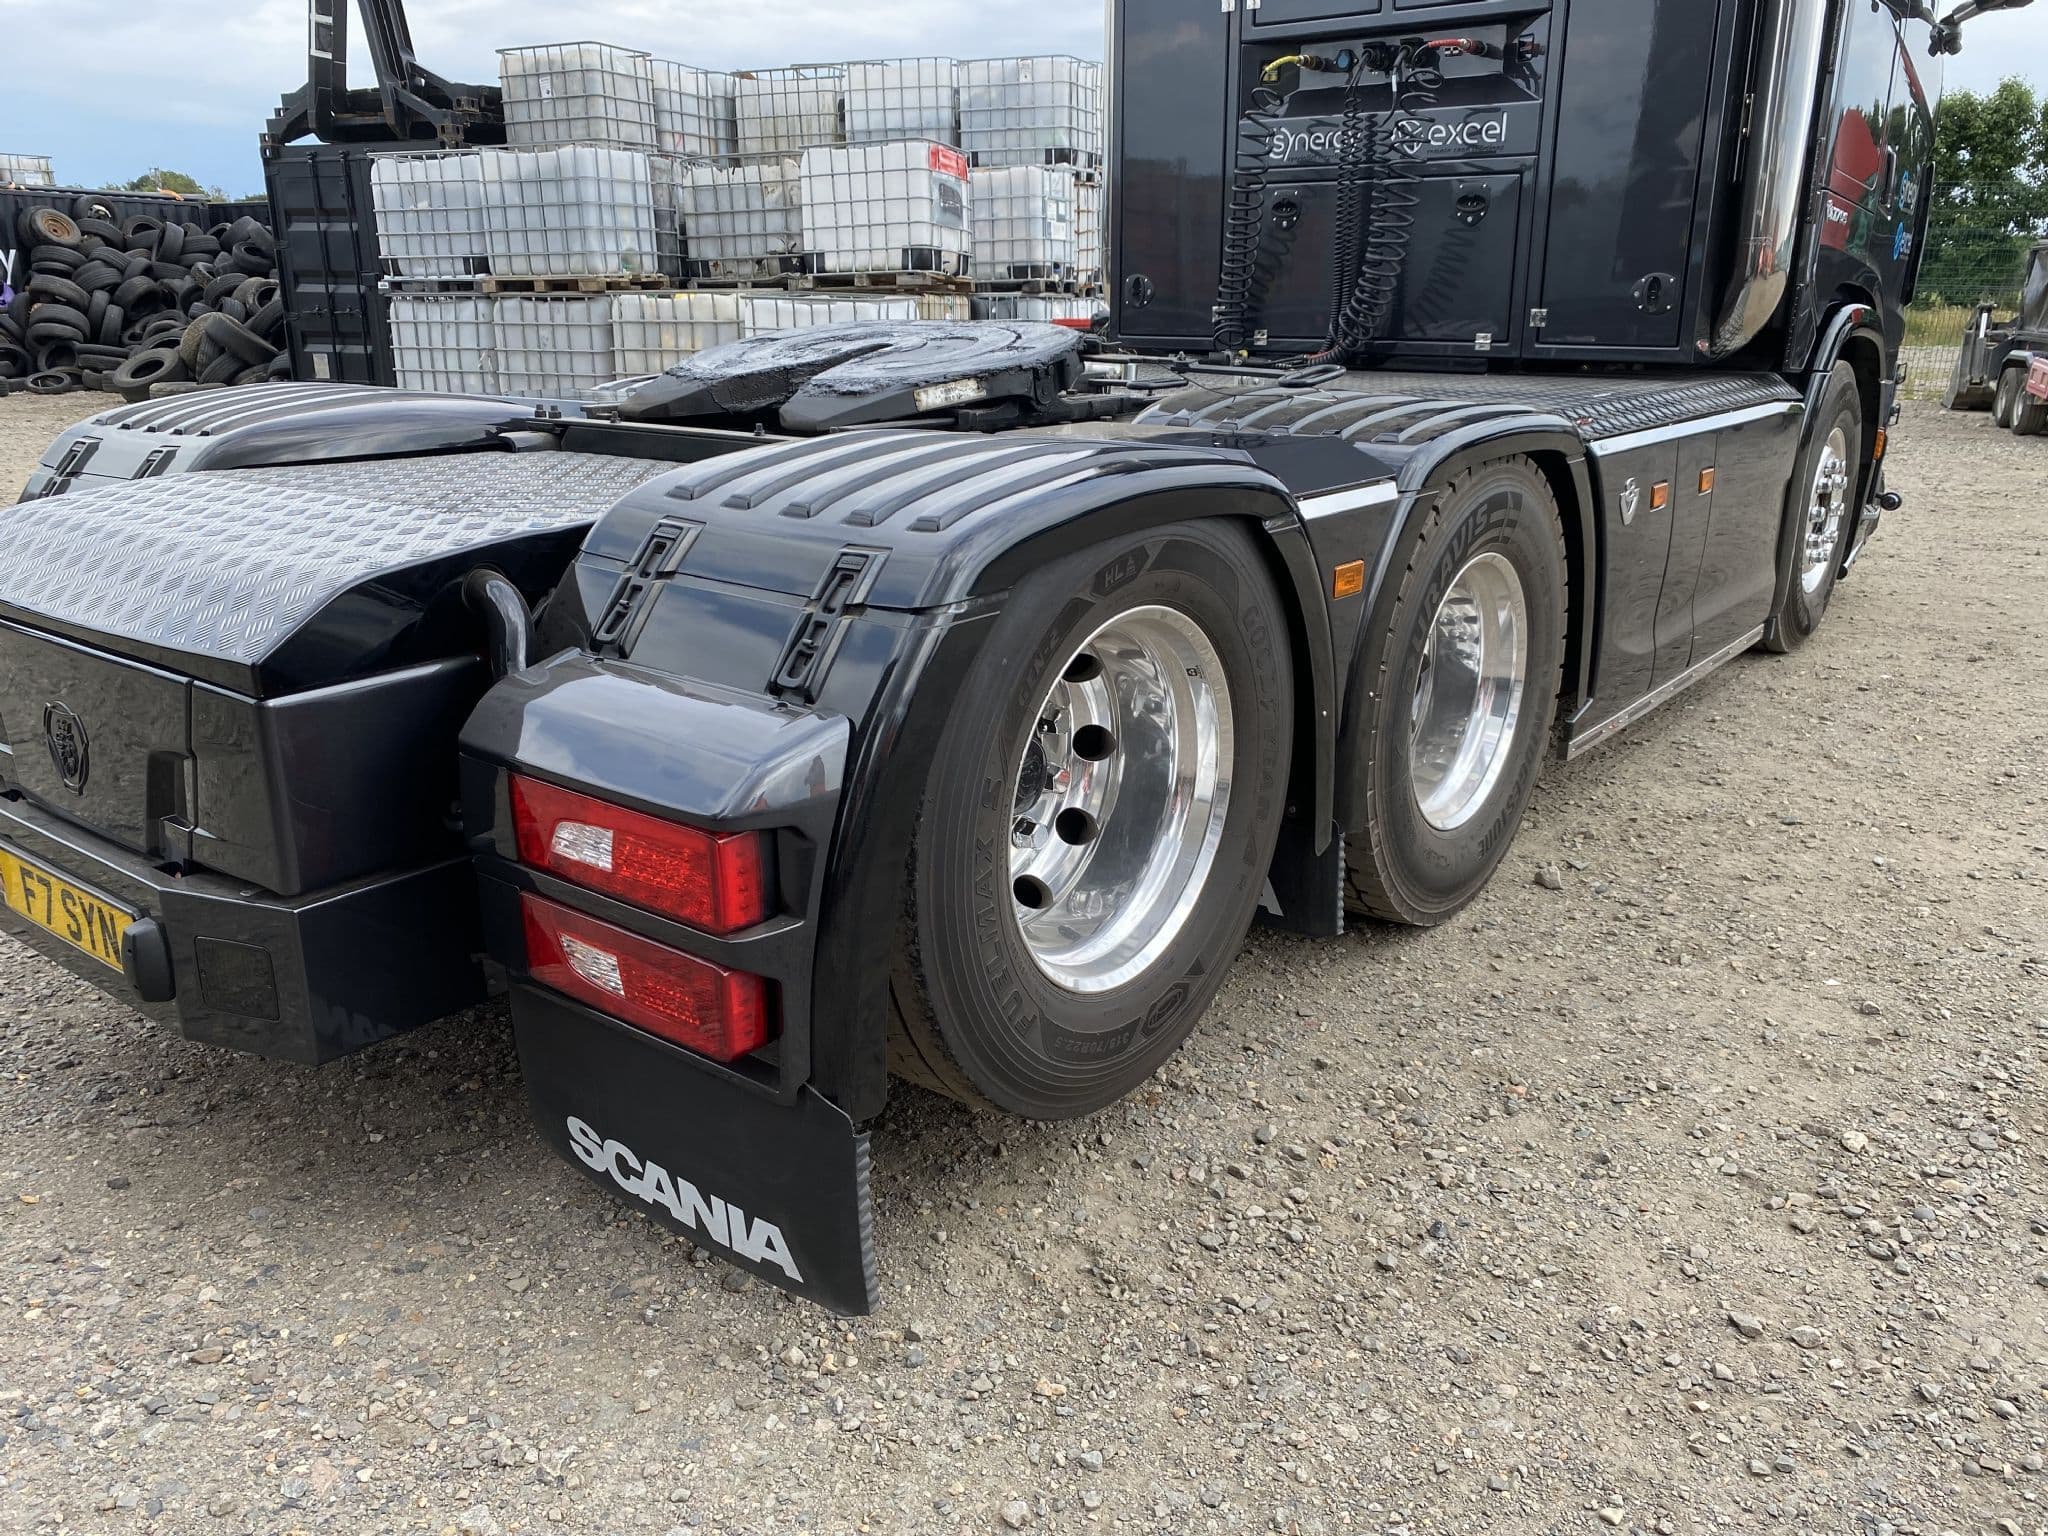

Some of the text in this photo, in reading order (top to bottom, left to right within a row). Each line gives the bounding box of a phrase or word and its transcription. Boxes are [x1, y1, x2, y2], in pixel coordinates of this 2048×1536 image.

[1428, 111, 1508, 145] excel
[19, 866, 122, 963] F7 SYN
[974, 833, 1038, 1035] FUELMAX
[566, 1115, 804, 1284] SCANIA
